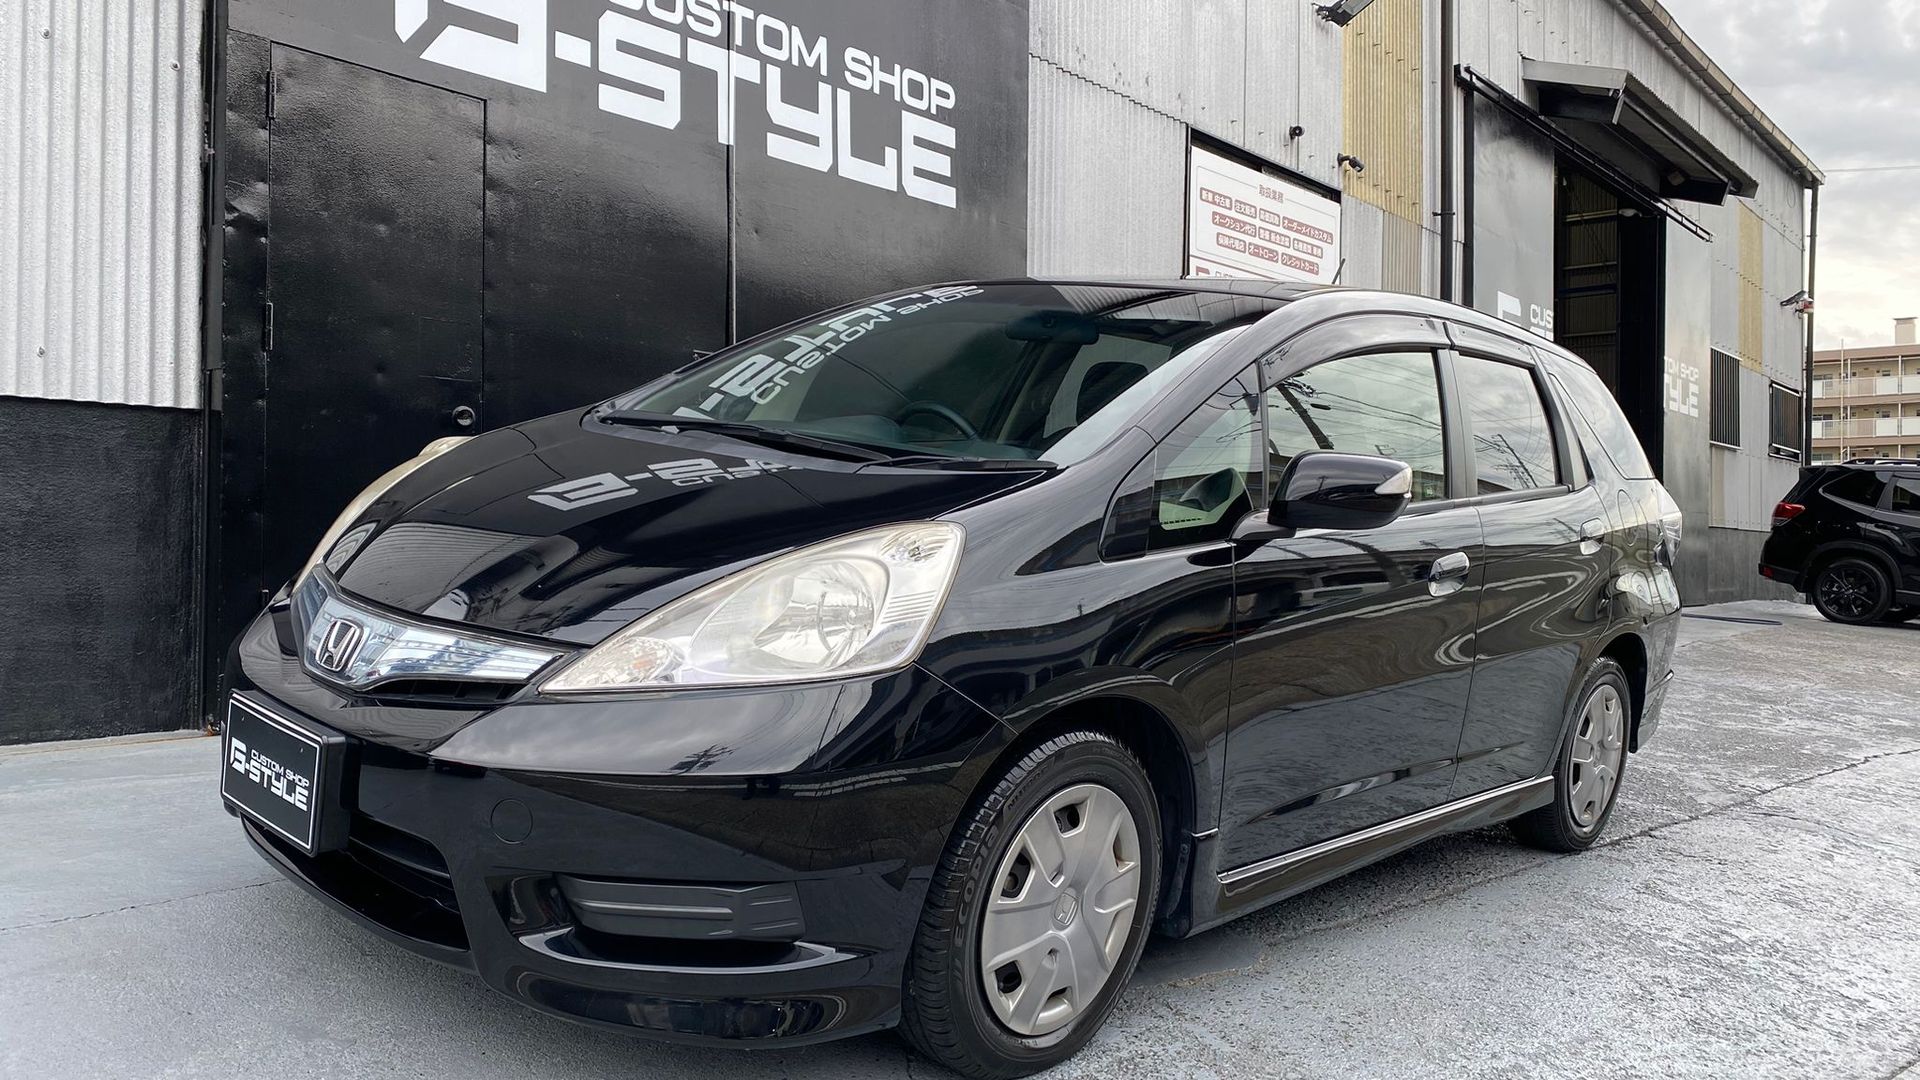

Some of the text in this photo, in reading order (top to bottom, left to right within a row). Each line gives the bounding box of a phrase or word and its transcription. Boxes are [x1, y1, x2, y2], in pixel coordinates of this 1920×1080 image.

[609, 0, 957, 115] USTOM SHOP
[1249, 244, 1278, 262] オートローン
[1282, 254, 1319, 274] クレジットカード
[230, 736, 309, 812] G-STYLE
[251, 749, 310, 787] CUSTOM SHOP
